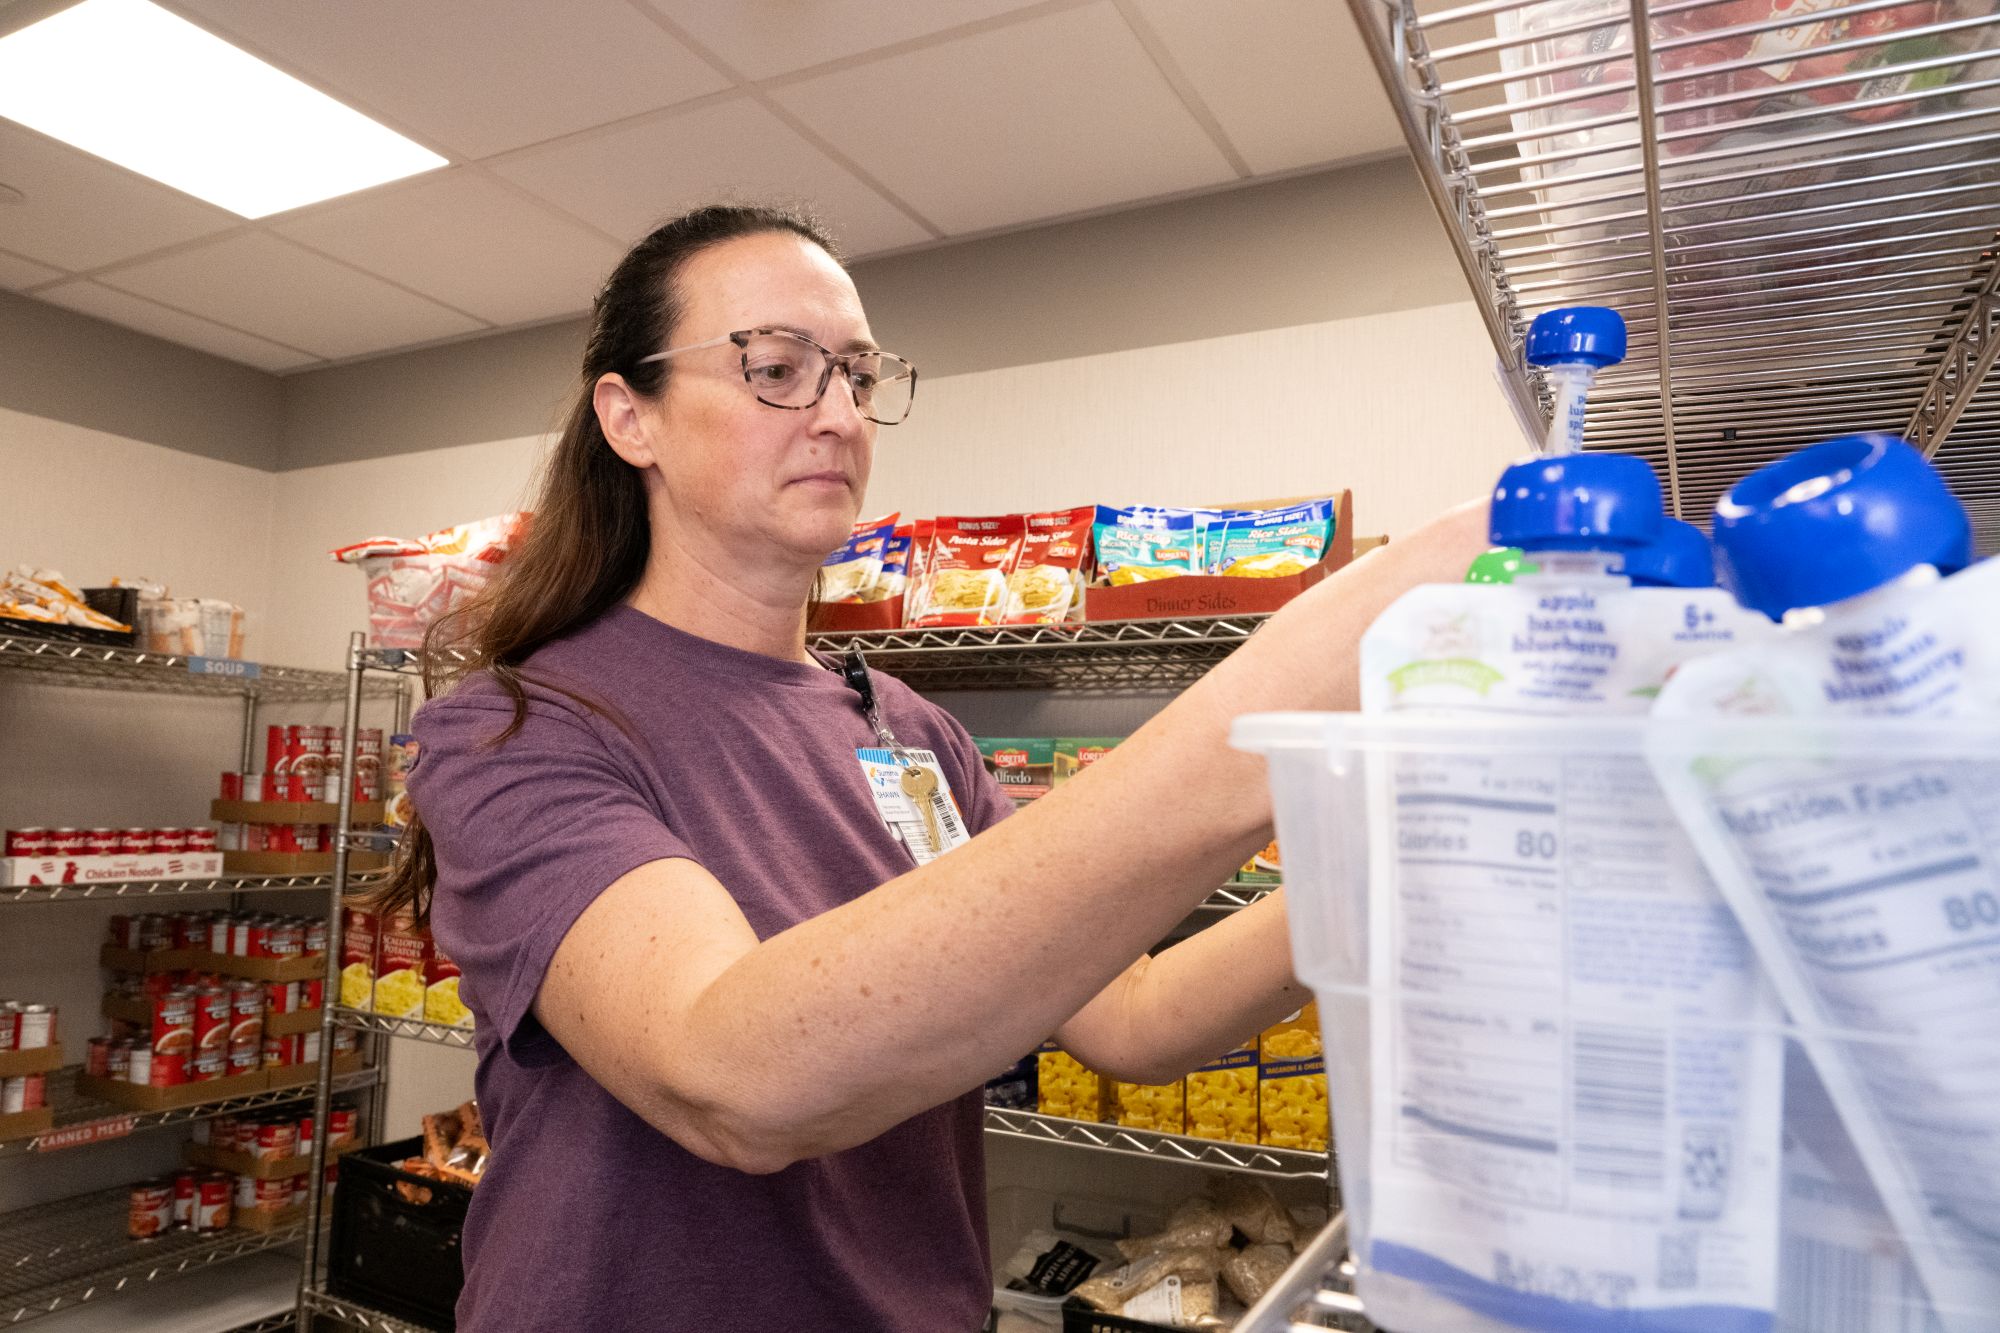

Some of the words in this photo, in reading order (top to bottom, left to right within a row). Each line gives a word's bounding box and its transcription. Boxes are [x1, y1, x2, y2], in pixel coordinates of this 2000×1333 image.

[1116, 530, 1139, 541] Rice
[1248, 529, 1275, 539] Rice
[1276, 525, 1308, 537] Sides
[949, 535, 979, 546] Pasta
[979, 536, 1008, 546] Sides
[1147, 596, 1193, 612] Dinner
[1198, 591, 1236, 610] Sides
[1527, 615, 1605, 633] banana
[1512, 634, 1617, 660] blueberry
[205, 660, 245, 675] SOUP
[1825, 648, 1964, 702] blueberry
[994, 752, 1026, 765] LORETTA
[994, 770, 1031, 784] Alfredo
[1516, 829, 1557, 859] 80
[85, 868, 126, 880] Chicken
[128, 867, 164, 877] Noodle
[1945, 892, 2000, 931] 80
[382, 934, 425, 950] SCALLOPED
[384, 943, 421, 958] POTATOES
[40, 1129, 93, 1147] CANNED
[96, 1120, 135, 1137] MEAT
